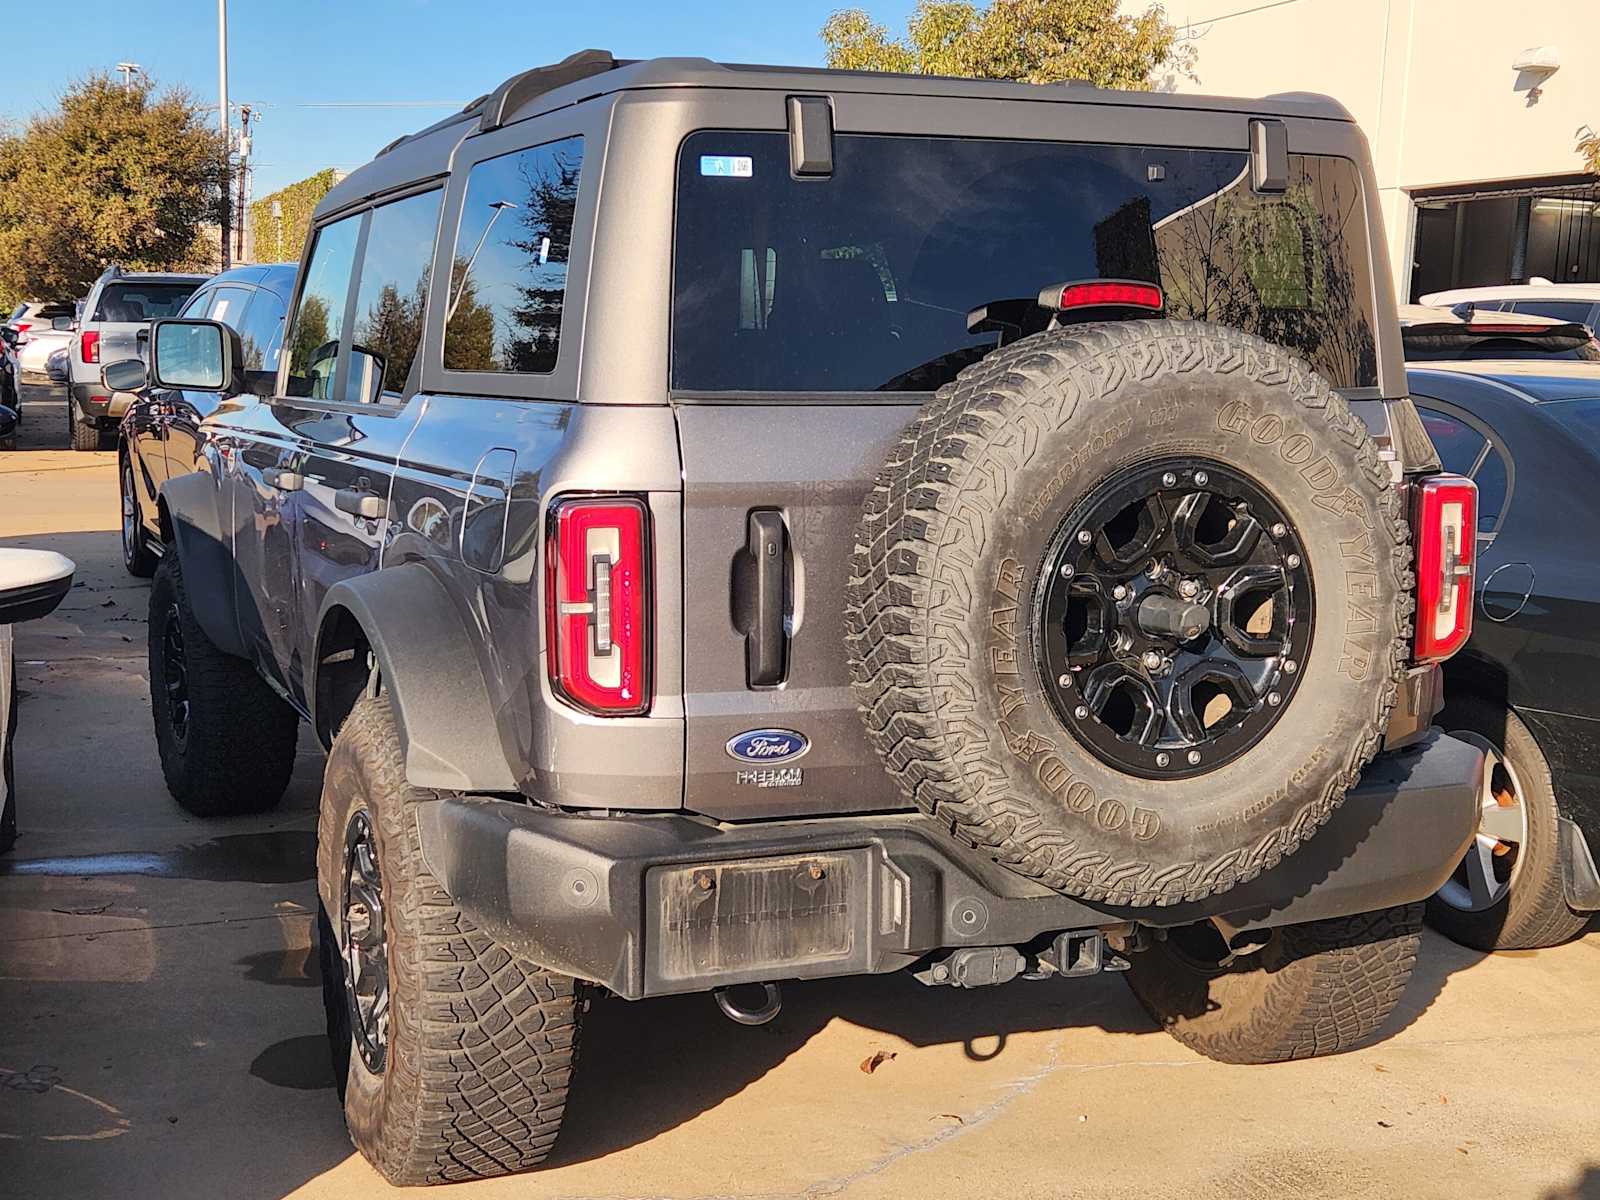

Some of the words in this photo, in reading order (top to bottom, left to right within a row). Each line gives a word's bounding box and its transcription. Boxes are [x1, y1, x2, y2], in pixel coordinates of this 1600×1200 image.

[1217, 399, 1377, 681] GOODYEAR
[747, 736, 791, 757] Ford
[991, 557, 1162, 841] GOODYEAR
